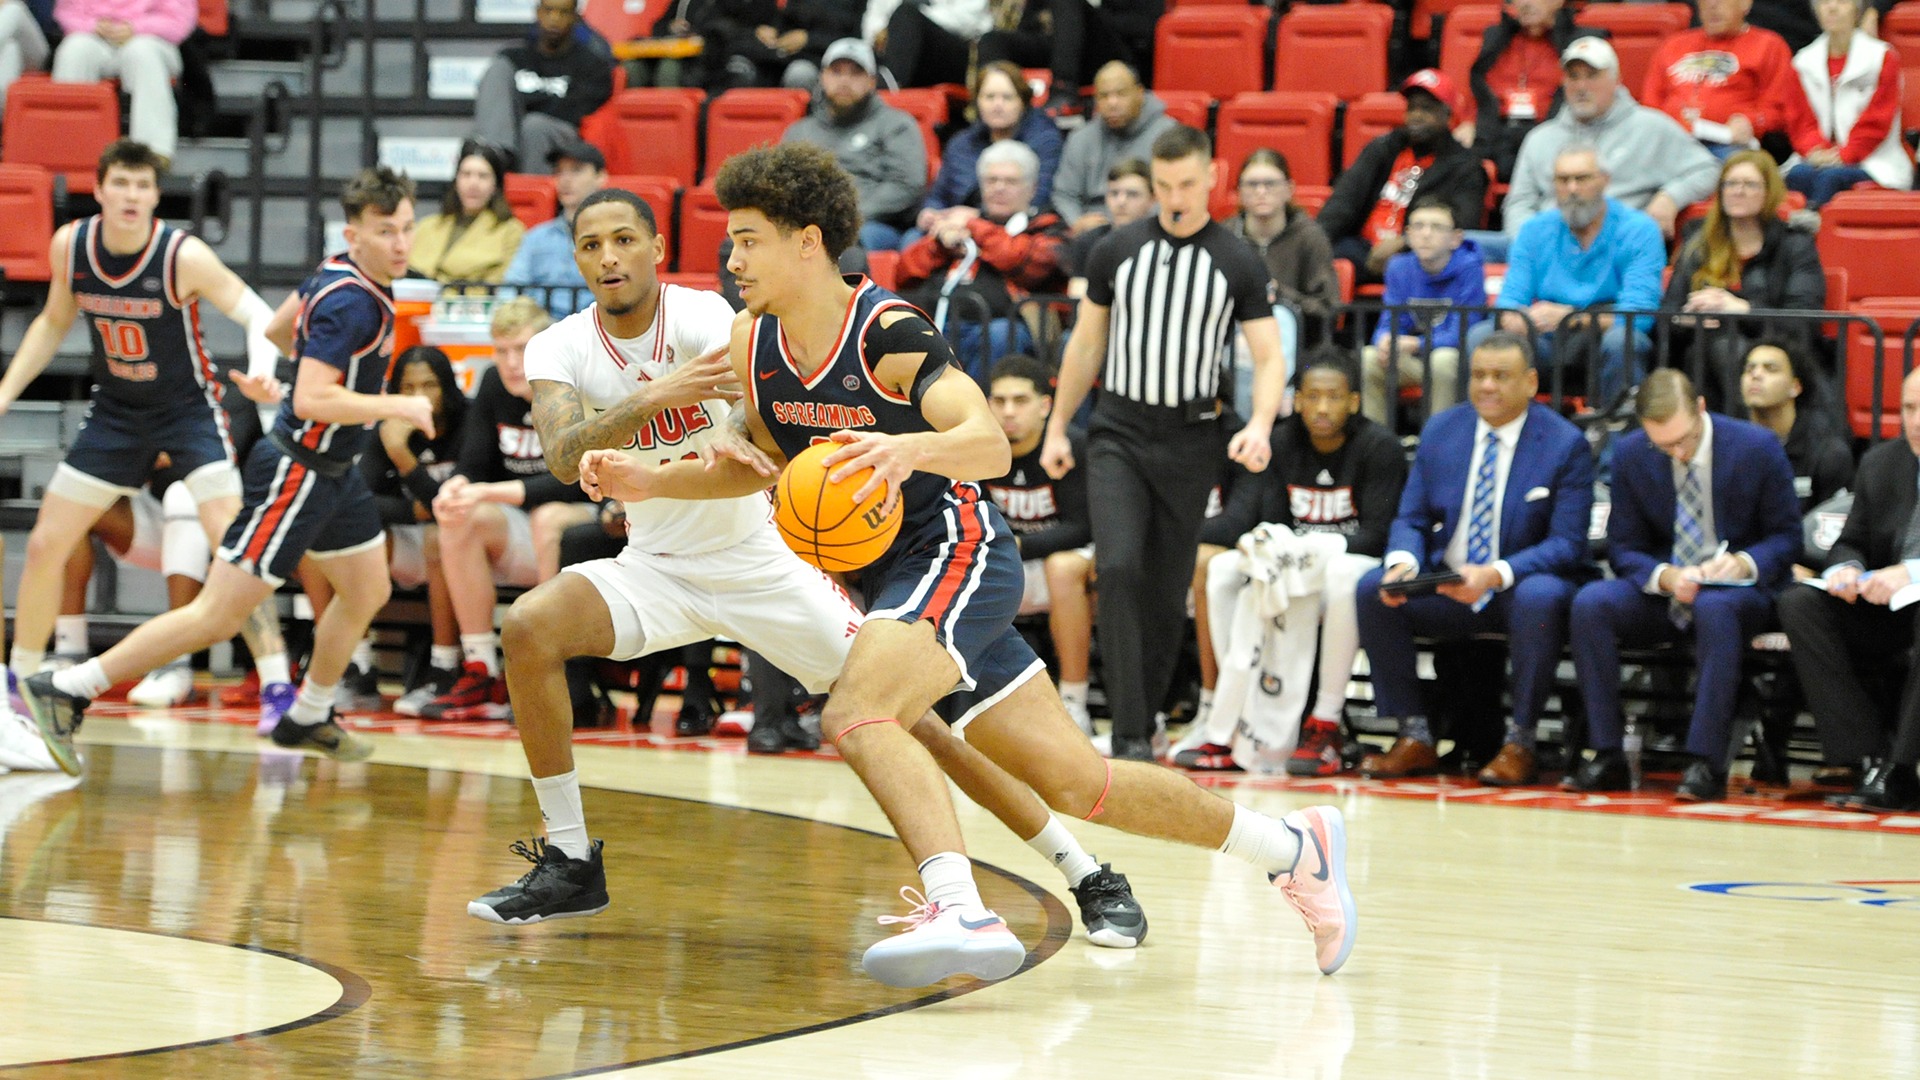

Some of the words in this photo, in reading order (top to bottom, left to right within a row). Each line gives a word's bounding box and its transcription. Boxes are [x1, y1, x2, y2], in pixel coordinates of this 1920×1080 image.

[94, 317, 149, 361] 10
[622, 402, 713, 450] IUE
[772, 401, 876, 428] SCREAMING
